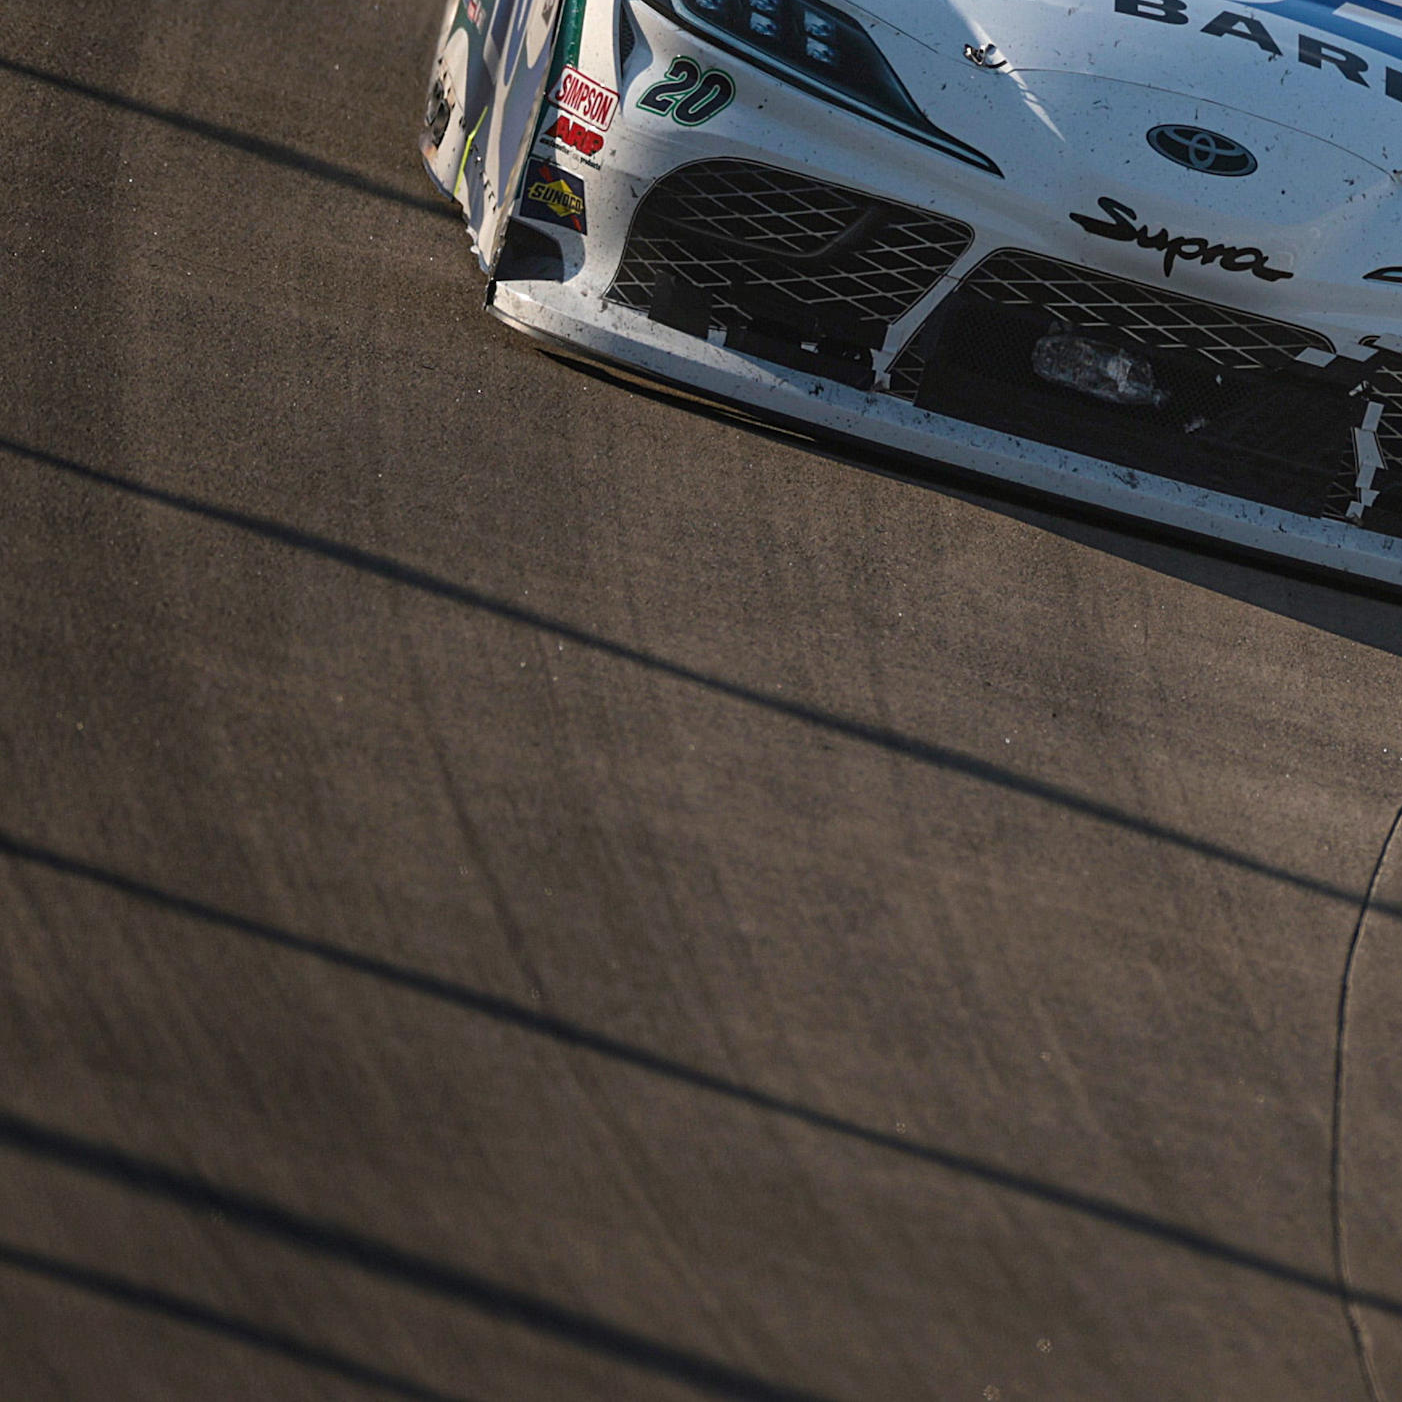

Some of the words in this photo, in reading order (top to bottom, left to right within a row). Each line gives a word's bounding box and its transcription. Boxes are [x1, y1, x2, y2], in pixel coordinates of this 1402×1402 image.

[556, 73, 614, 127] SIMPSON
[636, 55, 736, 126] 20
[544, 114, 604, 157] ARP
[530, 183, 582, 214] SUNOCO
[1068, 196, 1294, 281] Supra
